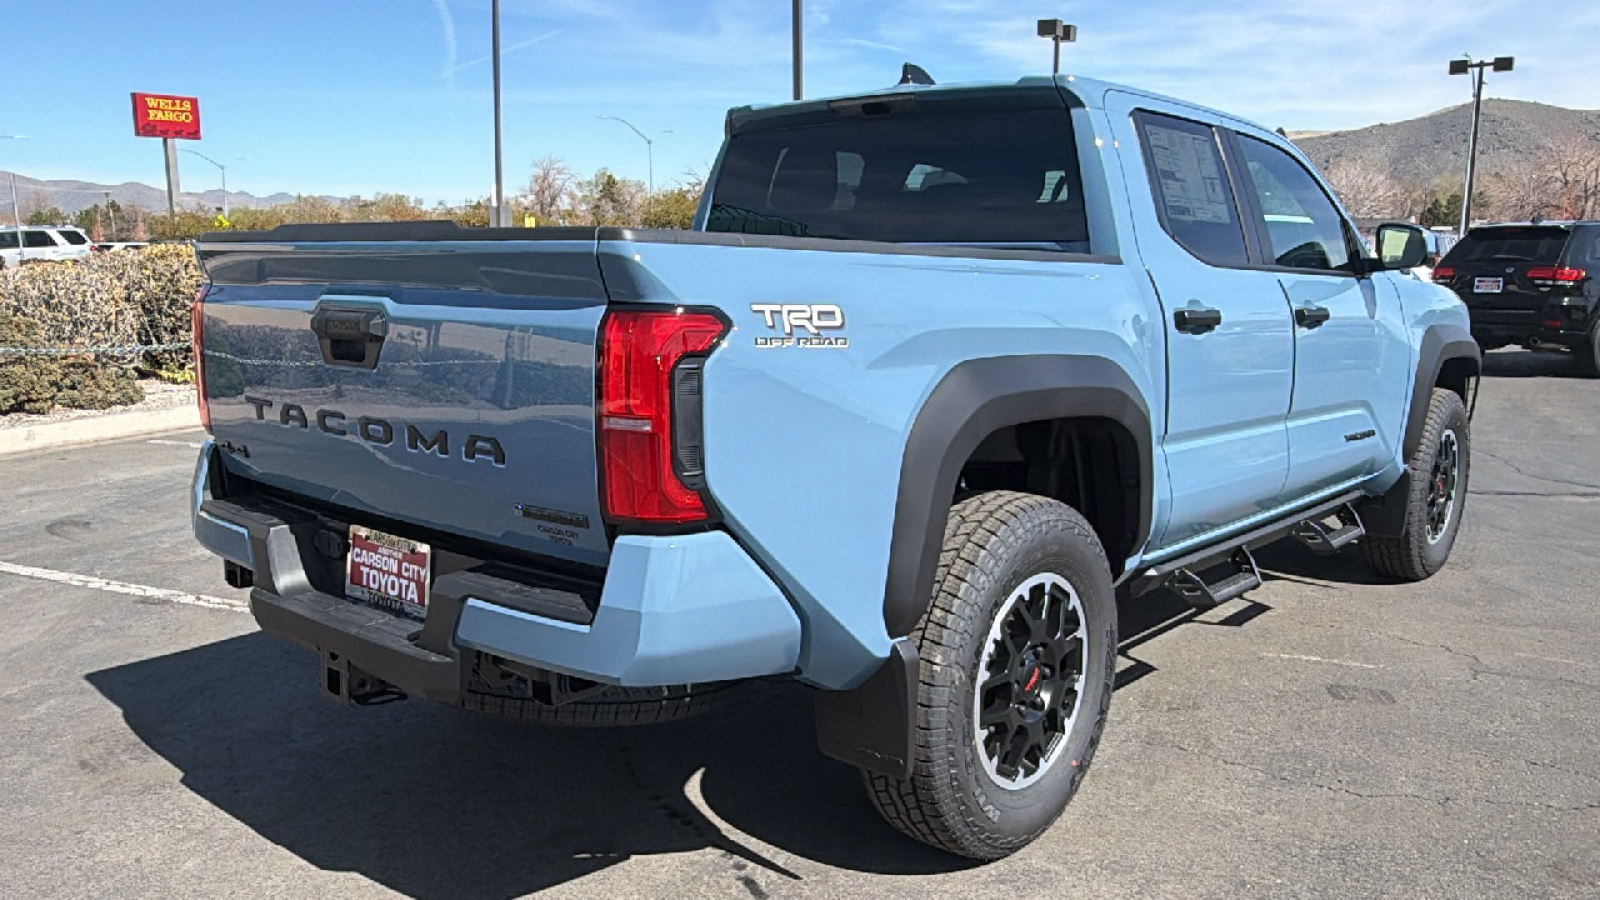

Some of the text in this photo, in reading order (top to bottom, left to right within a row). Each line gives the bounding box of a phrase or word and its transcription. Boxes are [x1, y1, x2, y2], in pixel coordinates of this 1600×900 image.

[145, 97, 191, 111] WELLS
[148, 109, 193, 123] FARGO
[750, 303, 845, 335] TRD
[755, 337, 849, 349] OFF ROAD
[245, 395, 506, 468] TACOMA
[369, 530, 396, 547] CARSON
[353, 547, 426, 584] CARSON CITY
[360, 565, 418, 603] TOYOTA
[367, 590, 405, 611] TOYOTA
